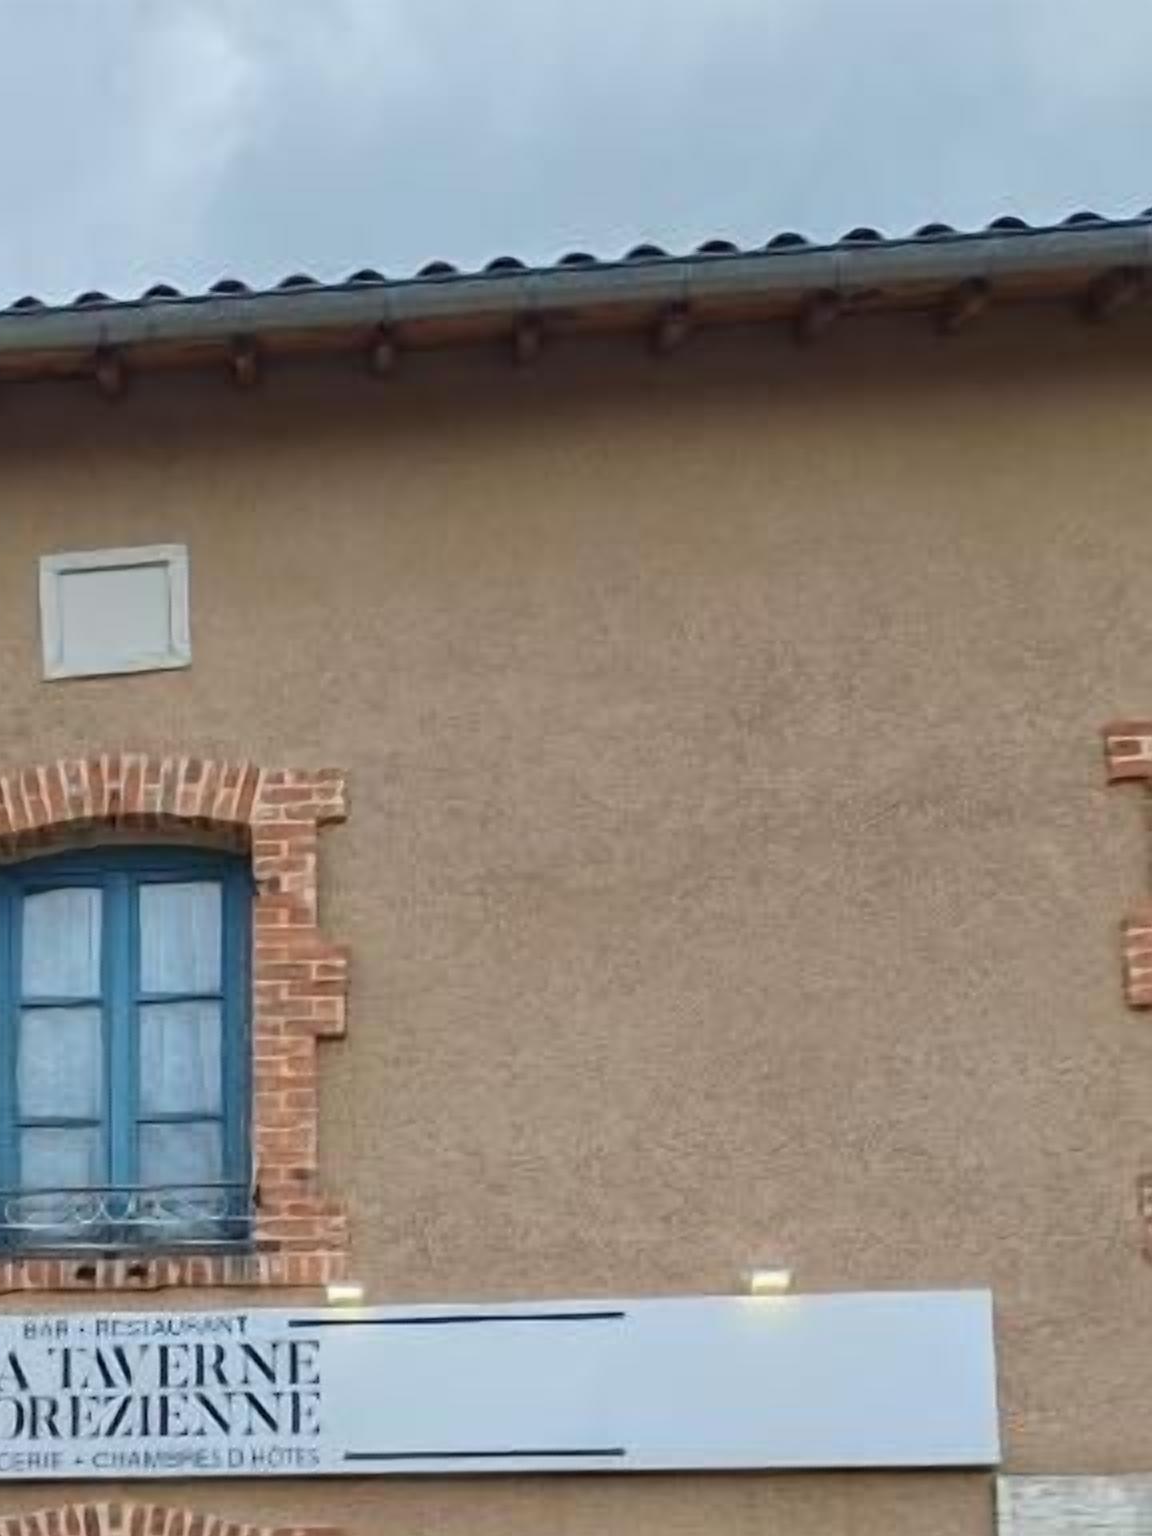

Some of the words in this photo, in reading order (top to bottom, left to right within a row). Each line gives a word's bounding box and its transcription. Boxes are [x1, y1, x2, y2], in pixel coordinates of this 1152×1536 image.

[23, 1320, 69, 1340] BAR
[95, 1315, 247, 1337] RESTAURANT
[47, 1341, 320, 1390] TAVERNE
[91, 1449, 222, 1470] CHAMBRES
